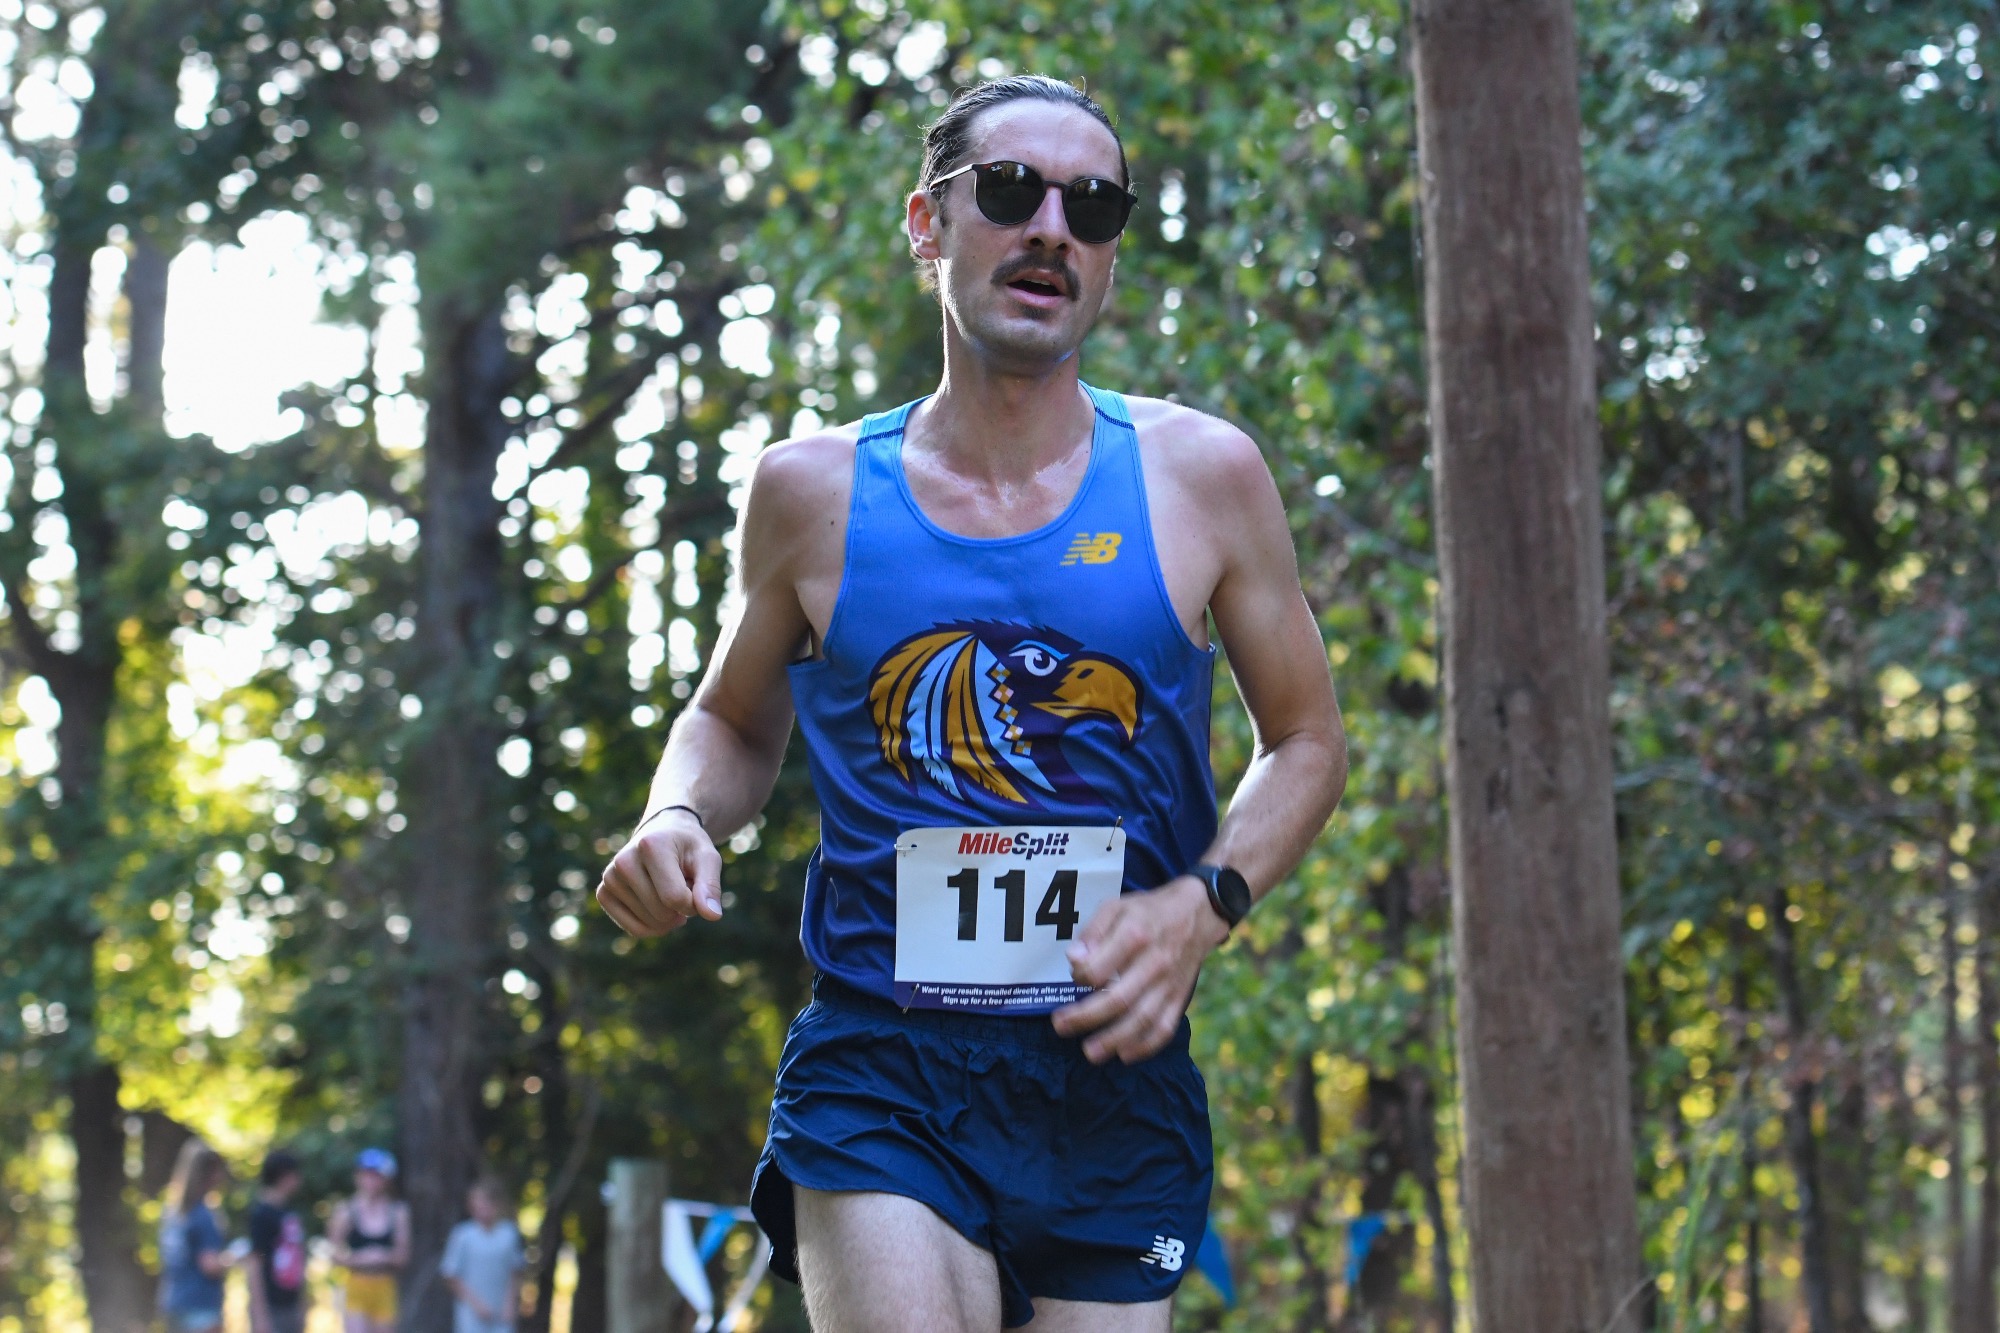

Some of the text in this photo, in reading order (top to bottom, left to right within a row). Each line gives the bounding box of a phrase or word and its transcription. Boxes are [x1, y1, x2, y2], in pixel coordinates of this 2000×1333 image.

[958, 832, 1069, 860] MileSplit
[947, 868, 1079, 942] 114
[921, 986, 940, 994] Want
[940, 987, 957, 996] your
[957, 987, 983, 996] results
[984, 988, 1012, 996] emailed
[1012, 986, 1040, 996] directly
[1040, 986, 1058, 995] after
[1059, 986, 1076, 994] your
[942, 995, 959, 1005] Sign
[959, 998, 970, 1006] up
[970, 997, 981, 1005] for
[988, 997, 1003, 1006] free
[1003, 996, 1032, 1005] account
[1044, 994, 1076, 1004] MileSplit
